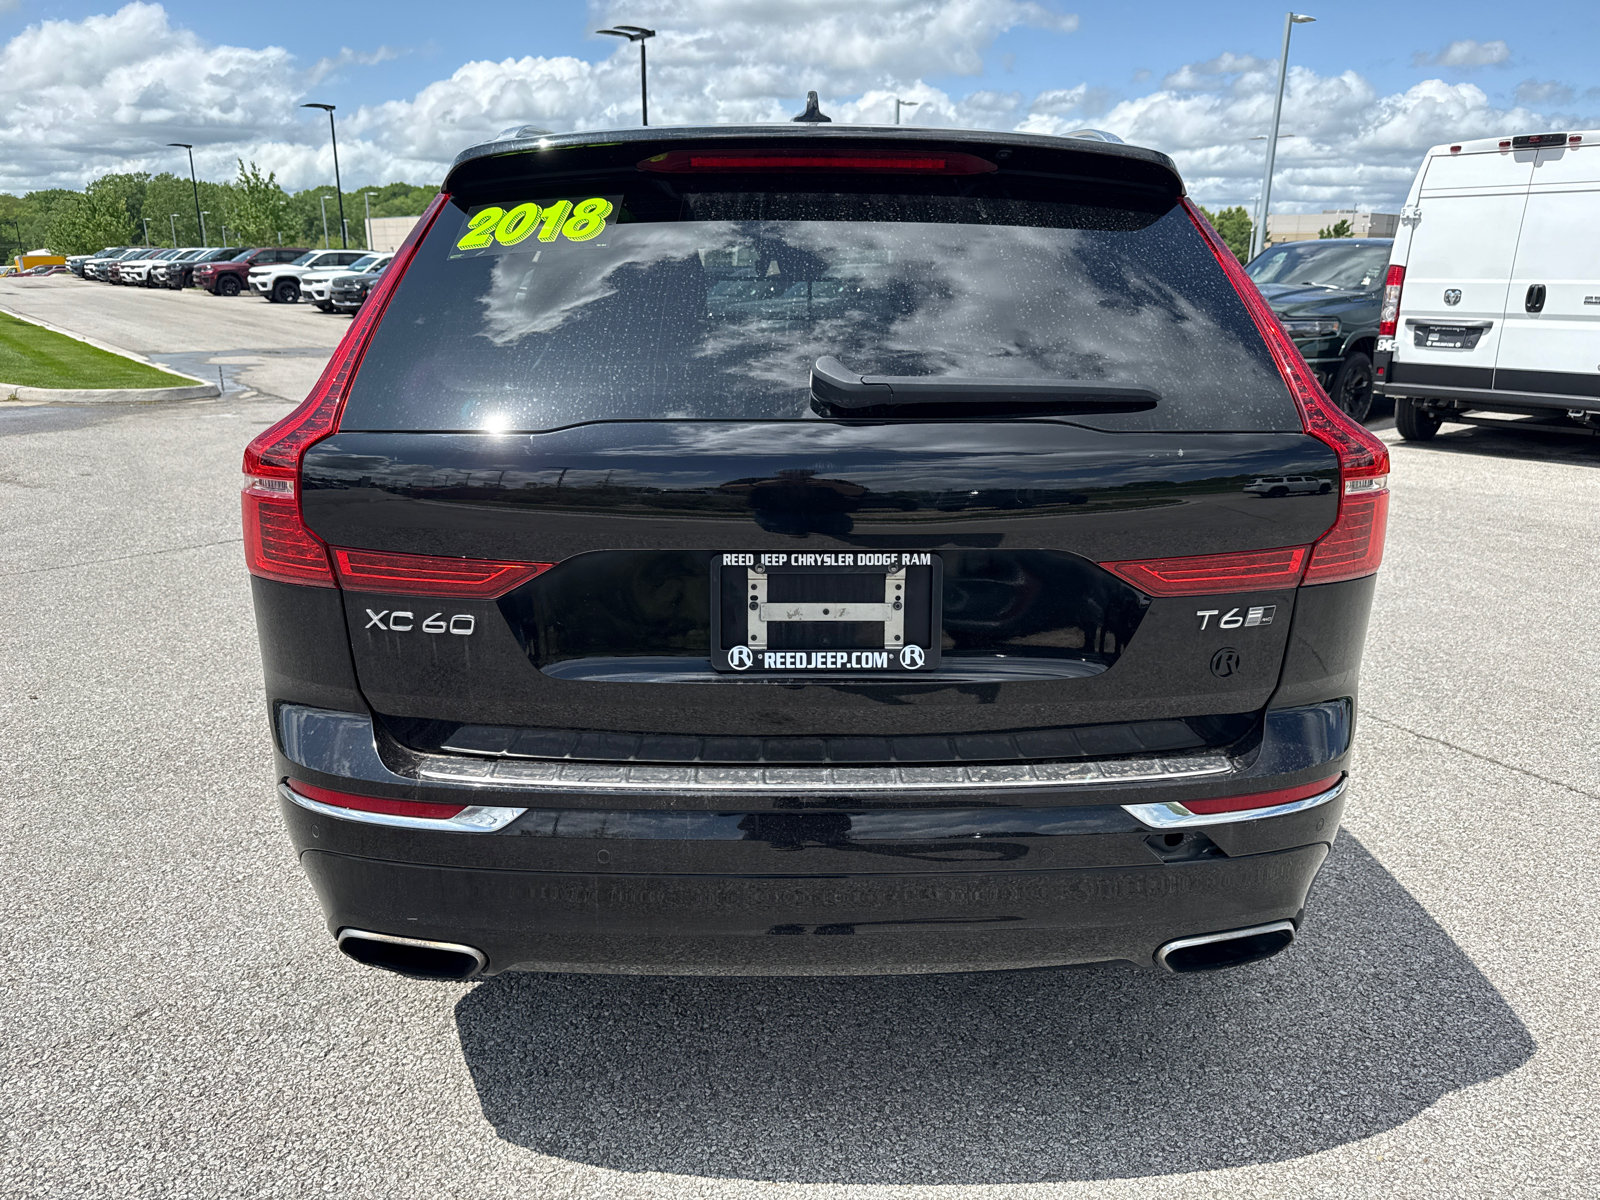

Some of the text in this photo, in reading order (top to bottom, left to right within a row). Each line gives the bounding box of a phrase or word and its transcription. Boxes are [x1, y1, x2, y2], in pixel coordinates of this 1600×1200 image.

[457, 197, 613, 251] 2018
[722, 553, 931, 566] REED JEEP CHRYSLER DODGE RAM
[1196, 607, 1244, 631] T6
[764, 651, 889, 669] REEDJEEP.COM
